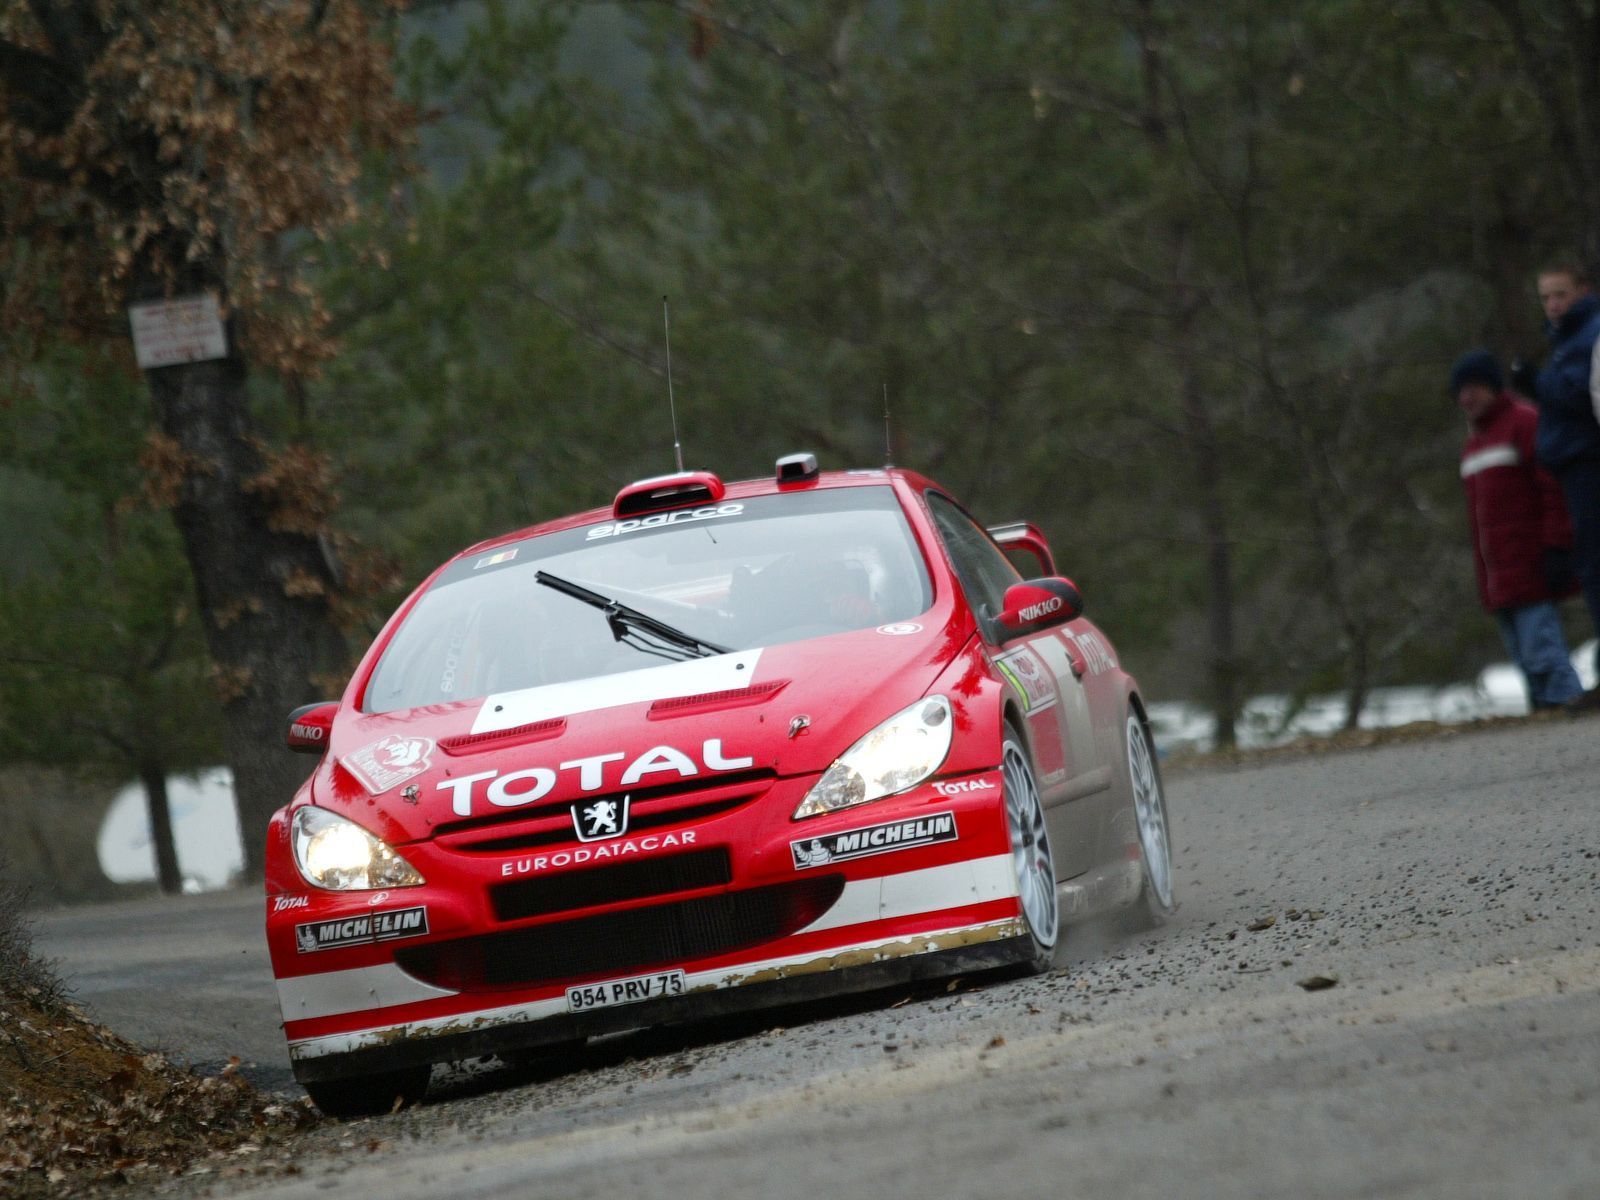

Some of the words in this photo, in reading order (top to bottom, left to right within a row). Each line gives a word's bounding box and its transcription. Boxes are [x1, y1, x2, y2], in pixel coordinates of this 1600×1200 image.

[585, 503, 744, 541] sparco
[1018, 597, 1062, 623] NIKKO
[436, 738, 753, 817] TOTAL
[932, 778, 996, 796] TOTAL
[835, 816, 951, 854] MICHELIN
[501, 830, 697, 877] EURODATACAR
[273, 895, 309, 912] TOTAL
[319, 911, 421, 942] MICHELIN
[571, 987, 607, 1008] 954
[612, 979, 651, 1001] PRV
[657, 973, 682, 993] 75
